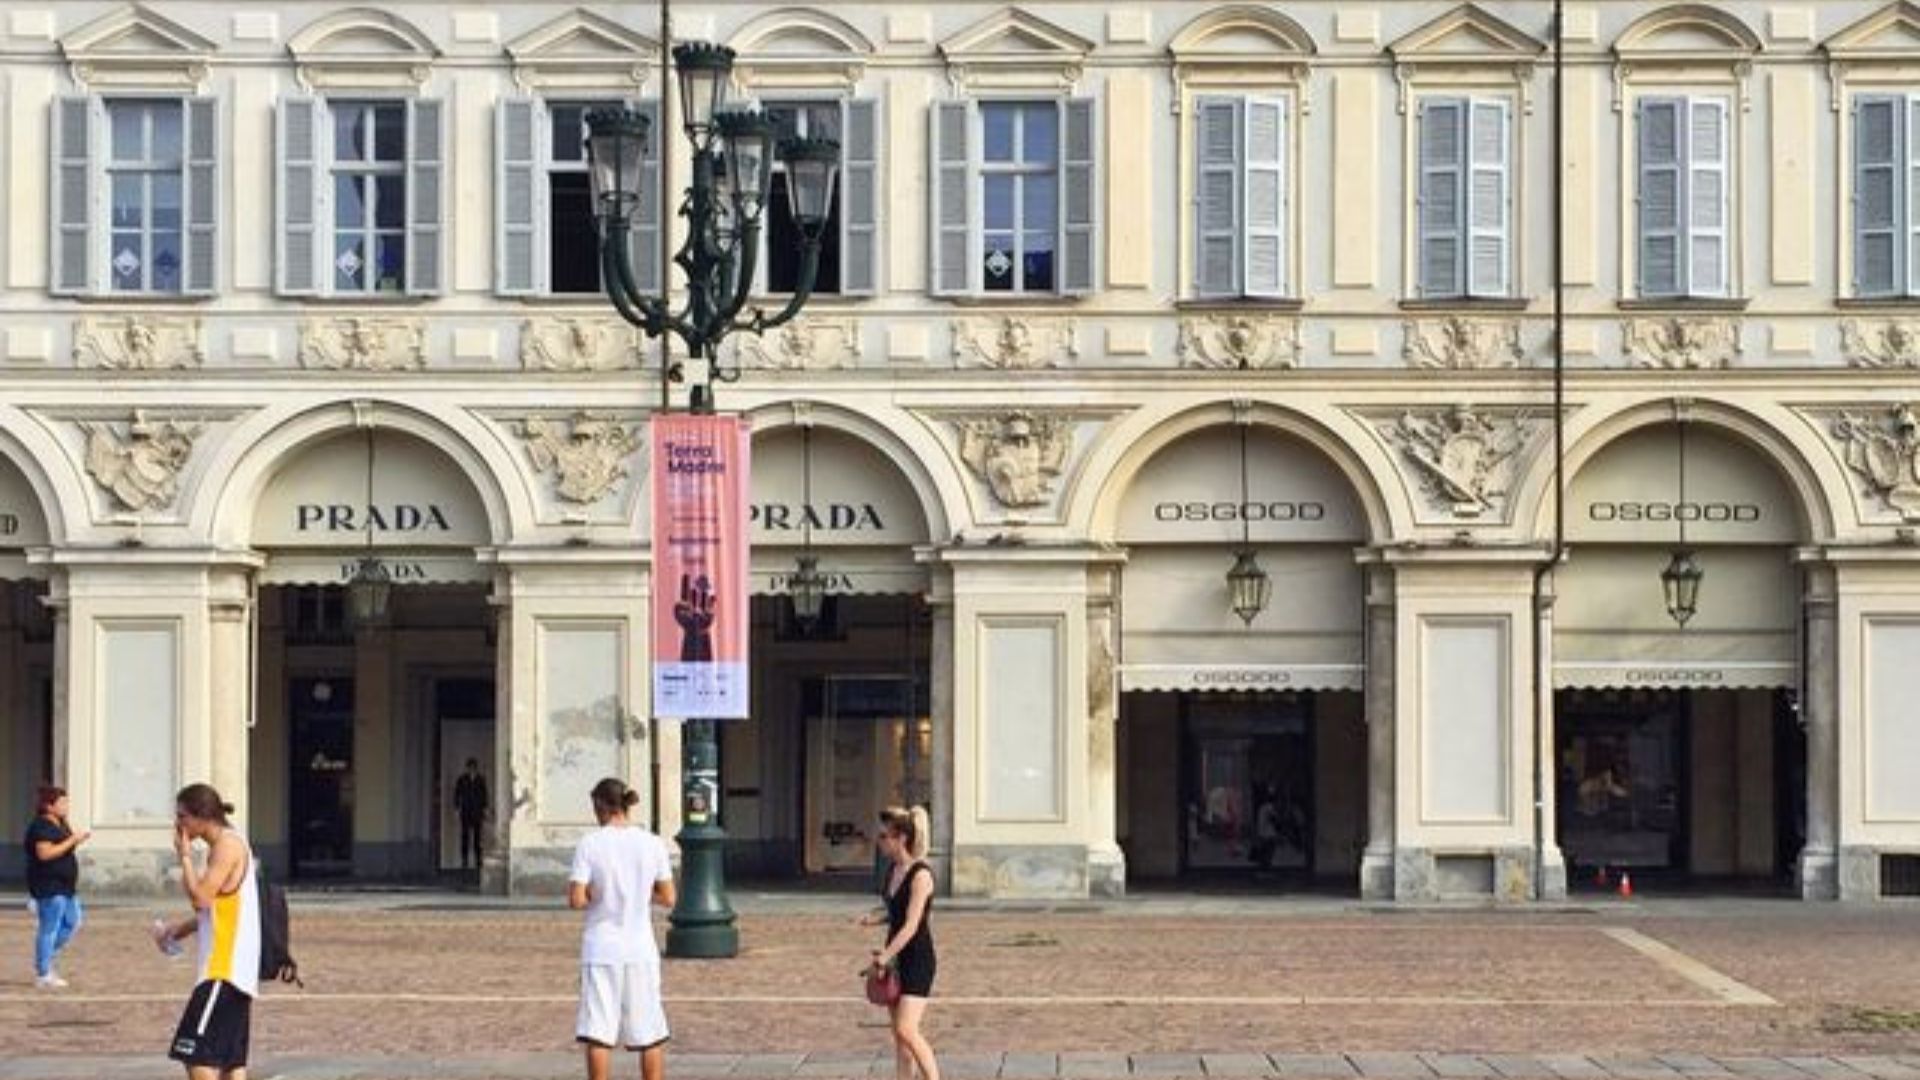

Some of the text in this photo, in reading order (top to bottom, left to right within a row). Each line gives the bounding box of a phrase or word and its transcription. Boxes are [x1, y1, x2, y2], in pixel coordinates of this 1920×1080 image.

[297, 504, 450, 530] PRADA
[1155, 502, 1324, 521] OSGOOD
[1589, 502, 1759, 521] OSGOOD
